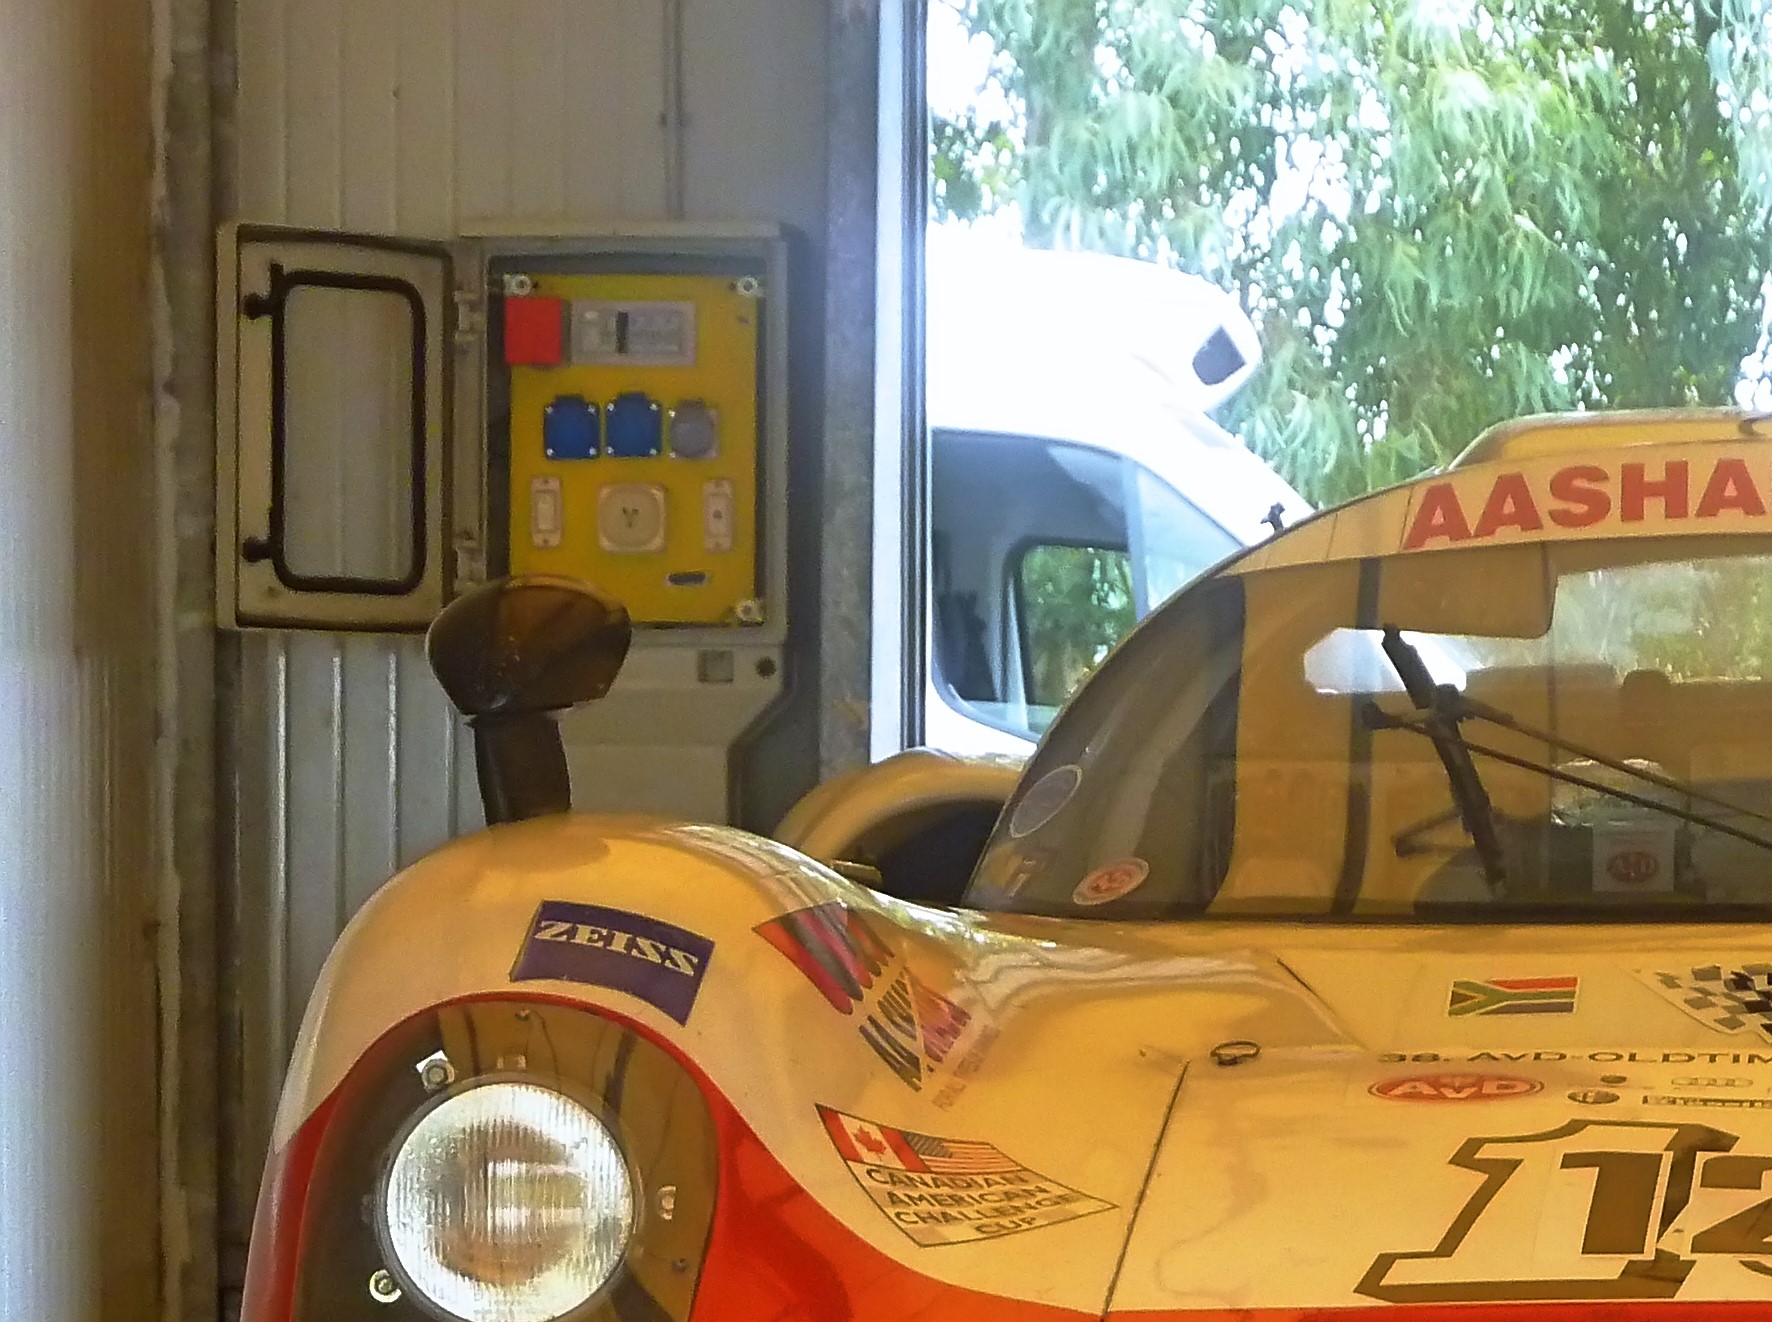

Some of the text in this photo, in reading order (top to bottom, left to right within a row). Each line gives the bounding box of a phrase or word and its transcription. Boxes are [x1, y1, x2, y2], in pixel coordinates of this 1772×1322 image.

[533, 920, 699, 977] ZEISS
[866, 1168, 1028, 1189] CANADIAN
[886, 1184, 1051, 1208] AMERICAN
[894, 1193, 1070, 1225] CHALLENGE
[974, 1216, 1037, 1235] CUP
